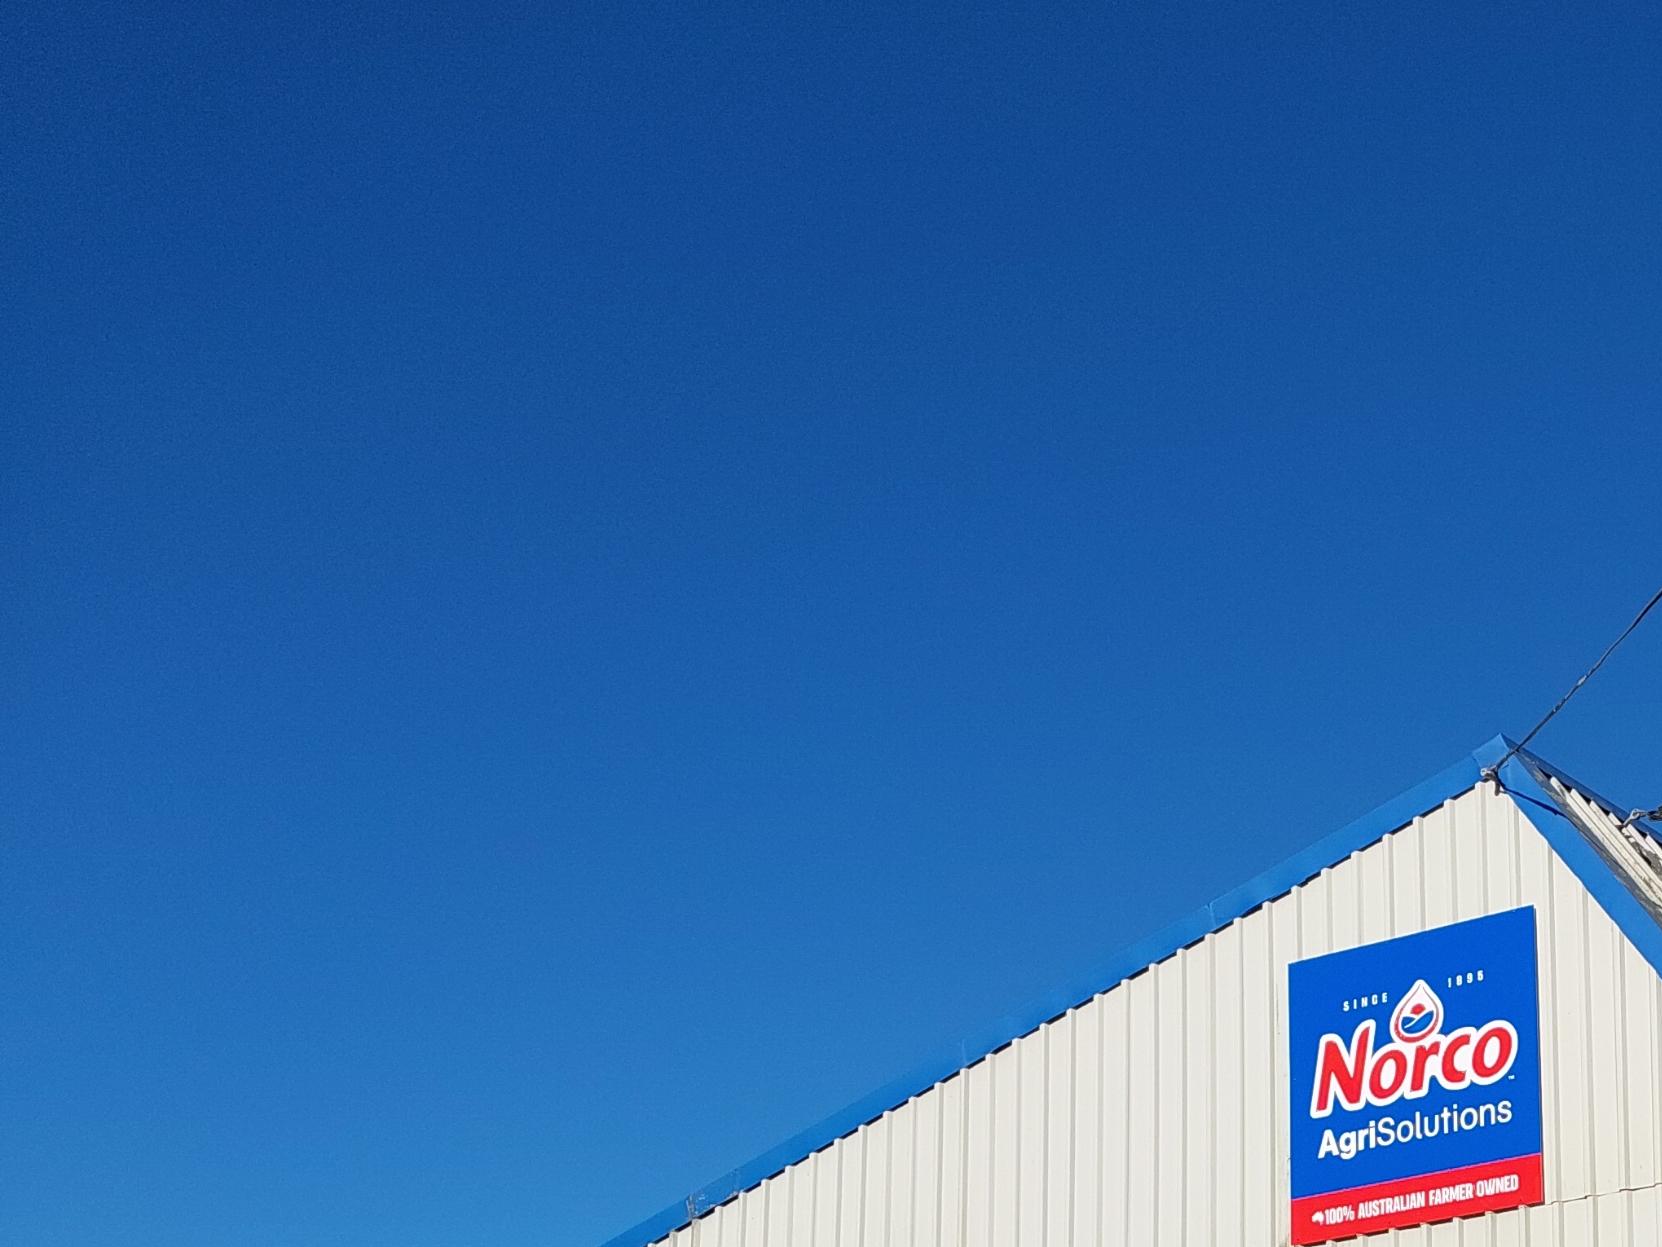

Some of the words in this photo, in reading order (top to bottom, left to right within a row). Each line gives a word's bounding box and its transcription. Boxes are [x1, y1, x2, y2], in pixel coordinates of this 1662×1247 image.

[1343, 993, 1388, 1011] SINCE
[1448, 970, 1484, 988] 1895
[1311, 1019, 1518, 1117] Norco
[1318, 1100, 1512, 1159] AgriSolutions
[1323, 1203, 1355, 1225] 100%
[1357, 1193, 1425, 1218] AUSTRALIAN
[1428, 1183, 1474, 1206] FARMER
[1476, 1174, 1519, 1197] OWNED
